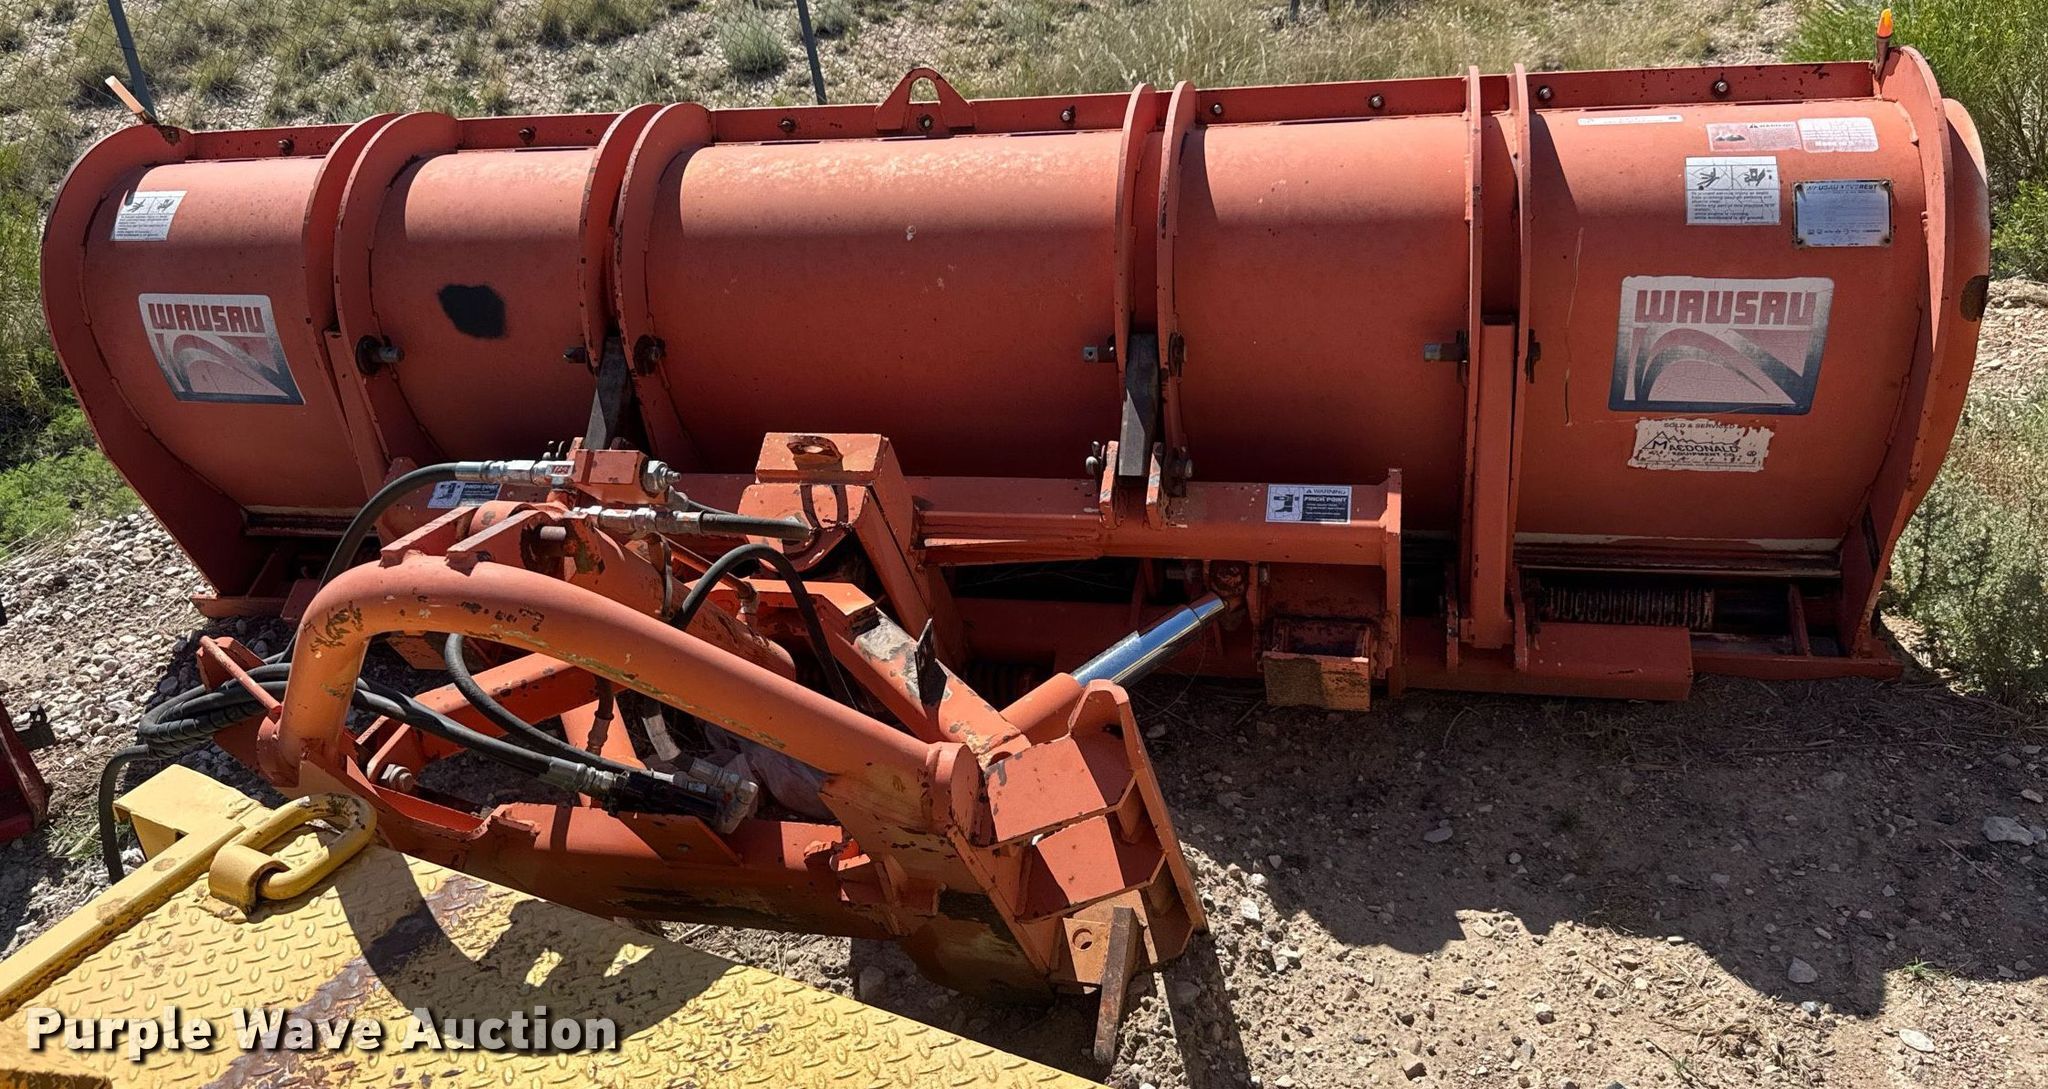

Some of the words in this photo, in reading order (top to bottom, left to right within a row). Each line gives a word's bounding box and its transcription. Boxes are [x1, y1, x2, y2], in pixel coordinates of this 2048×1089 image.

[147, 303, 266, 333] WAUSAU
[1634, 290, 1817, 325] WAUSAU
[1652, 440, 1739, 453] MACDONALD
